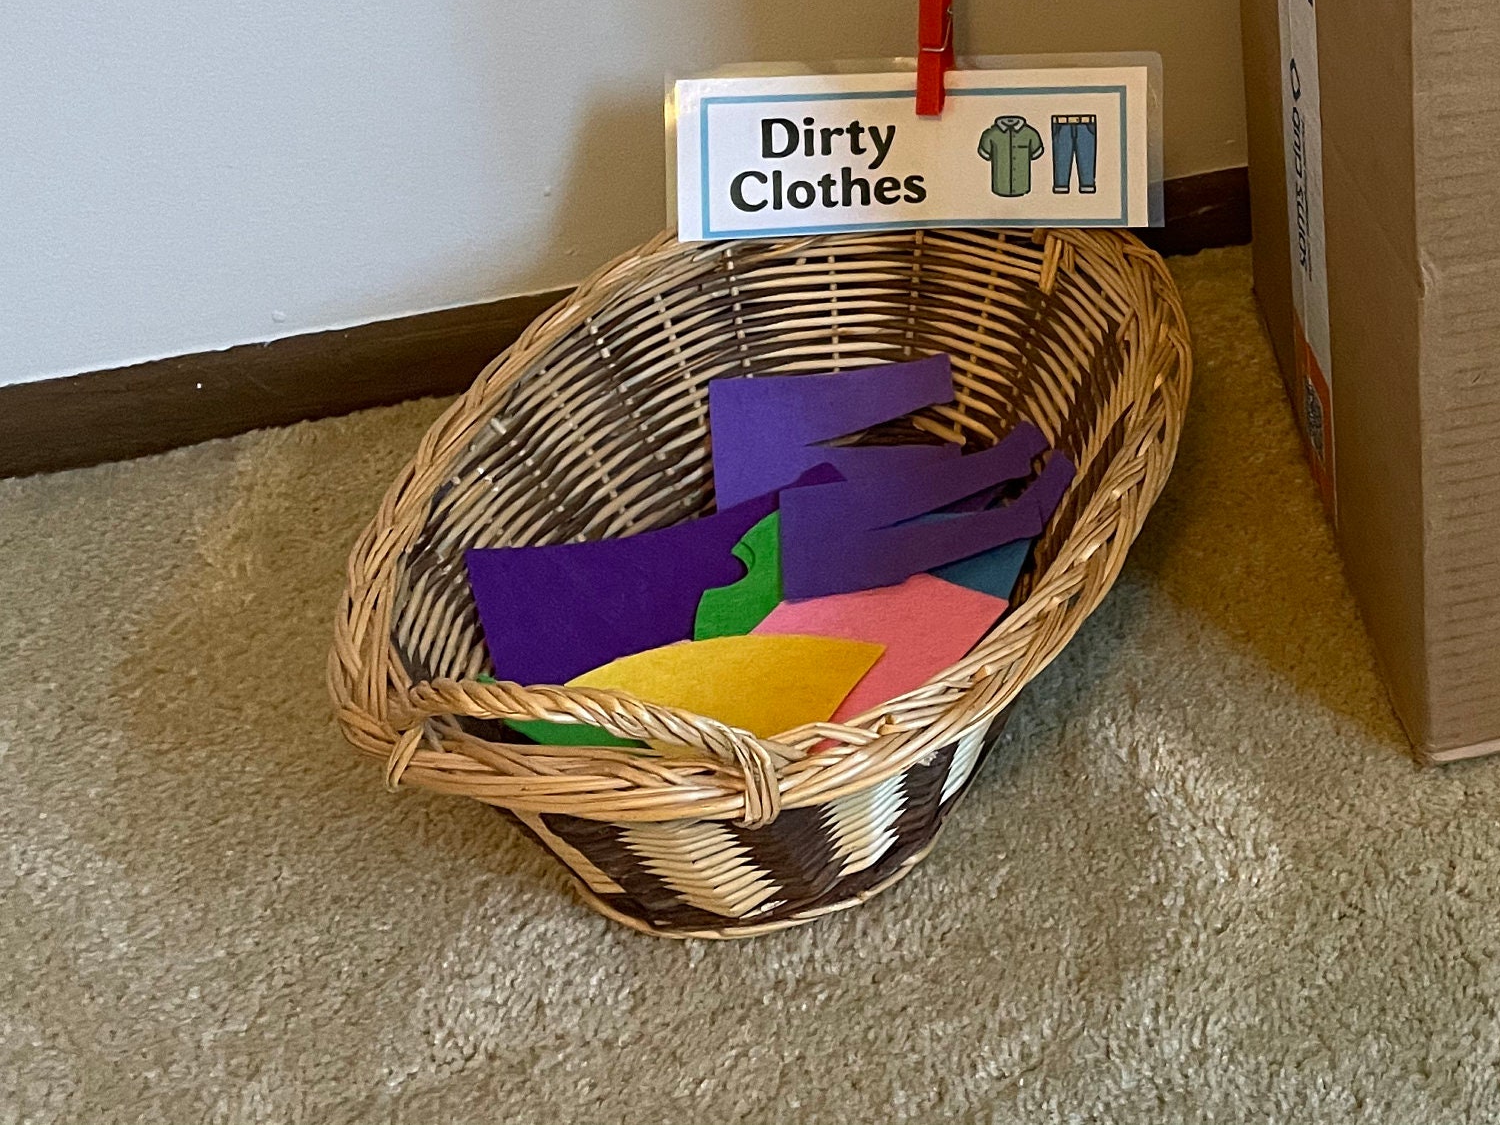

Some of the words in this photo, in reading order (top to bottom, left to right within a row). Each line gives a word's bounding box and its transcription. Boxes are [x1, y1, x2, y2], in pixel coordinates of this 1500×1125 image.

[761, 116, 896, 170] Dirty
[1292, 106, 1302, 178] club
[730, 167, 927, 212] Clothes
